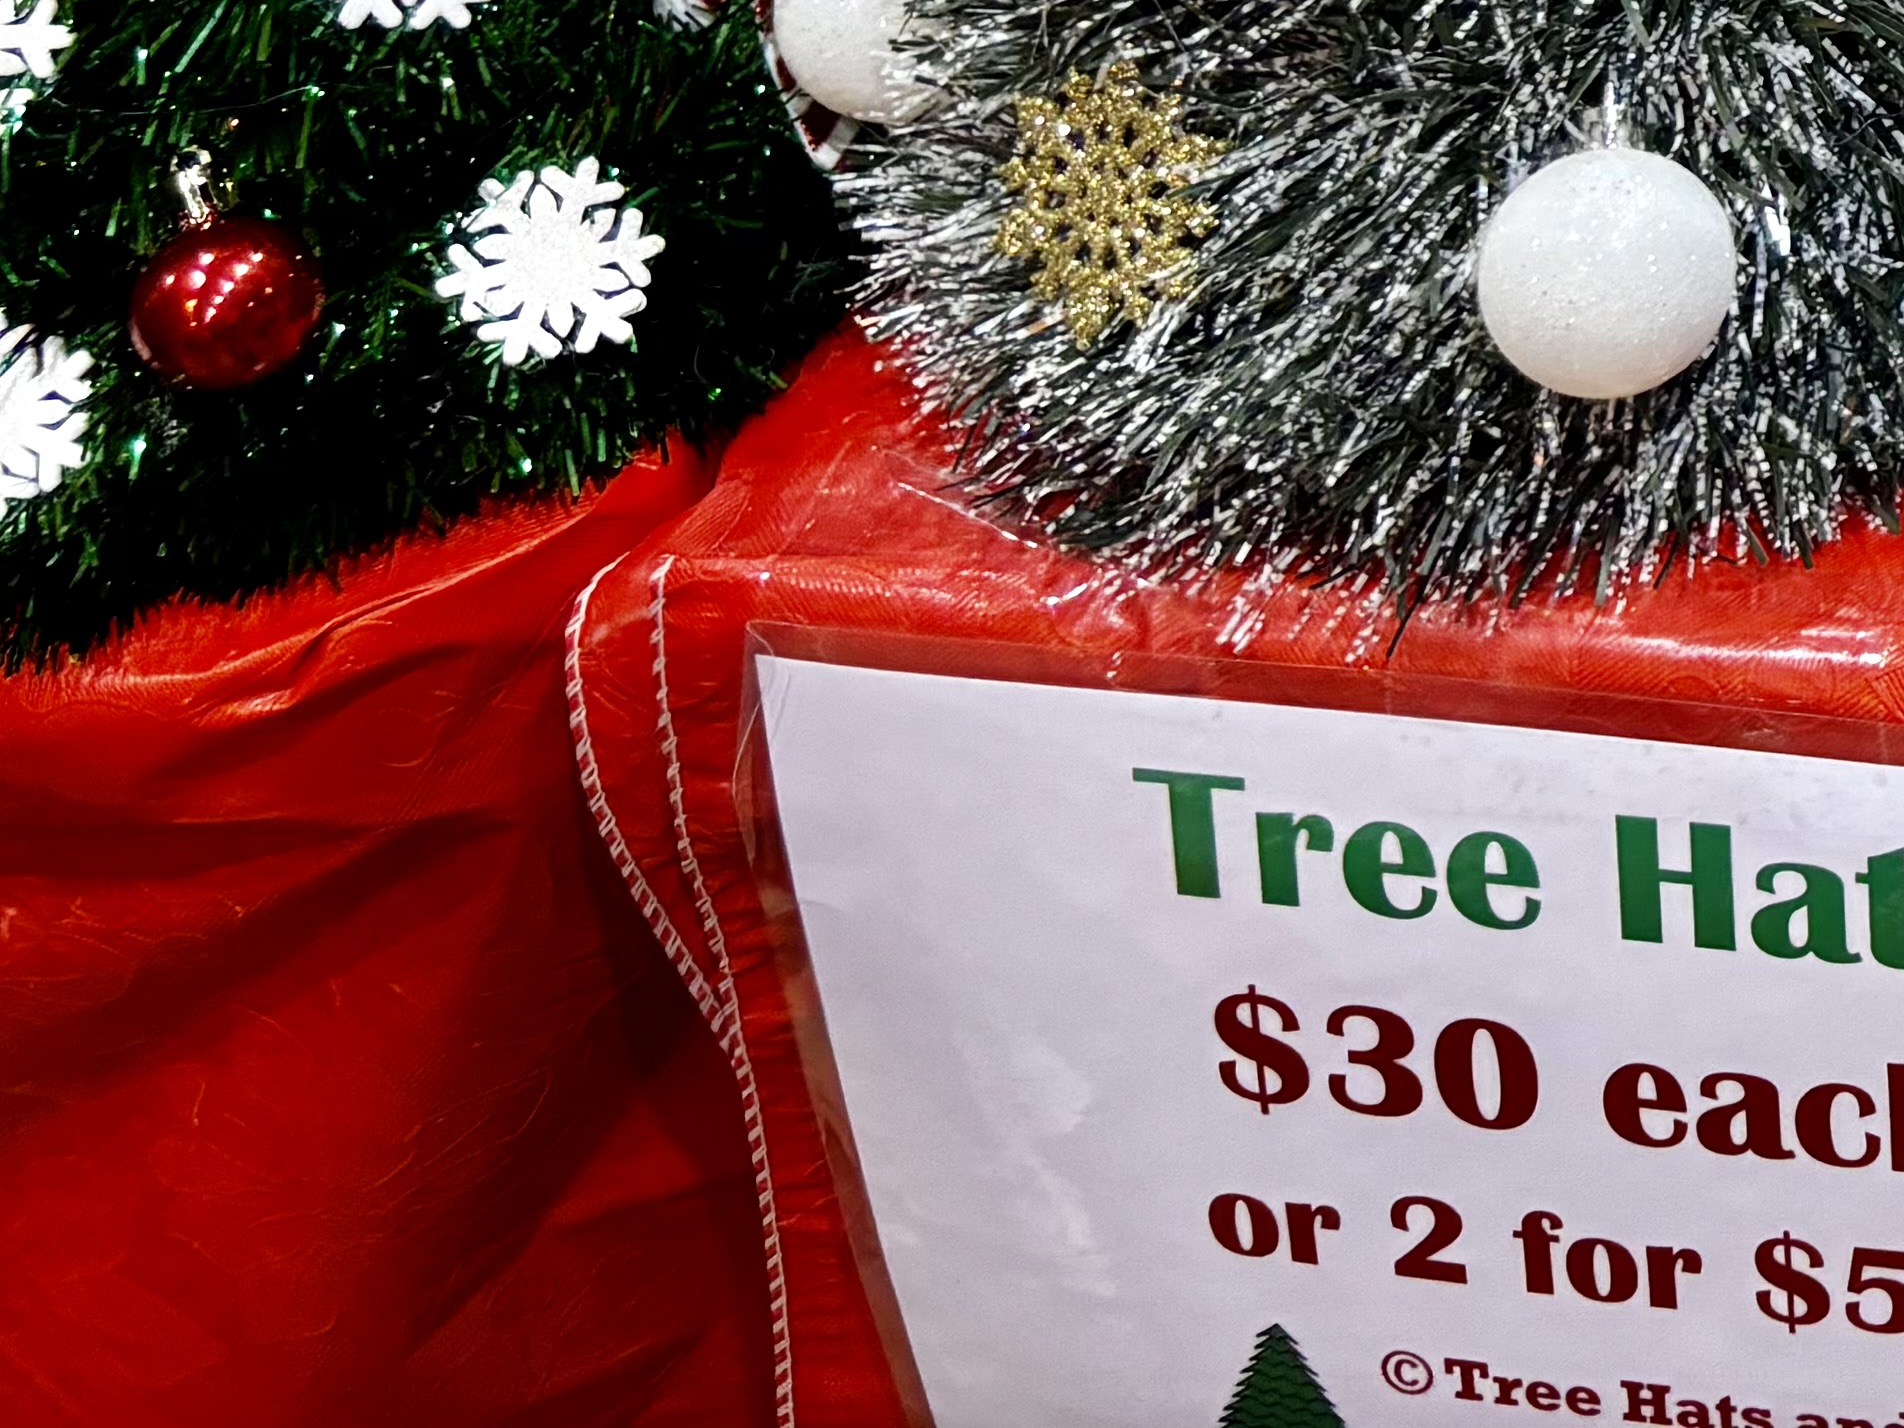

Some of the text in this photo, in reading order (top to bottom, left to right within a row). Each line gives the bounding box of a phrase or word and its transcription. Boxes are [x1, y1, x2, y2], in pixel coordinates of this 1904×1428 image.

[1132, 767, 1541, 931] Tree
[1213, 983, 1539, 1132] $30
[1208, 1191, 1341, 1266] or
[1389, 1194, 1469, 1285] 2
[1512, 1209, 1703, 1310] for
[1620, 1378, 1776, 1428] Hats
